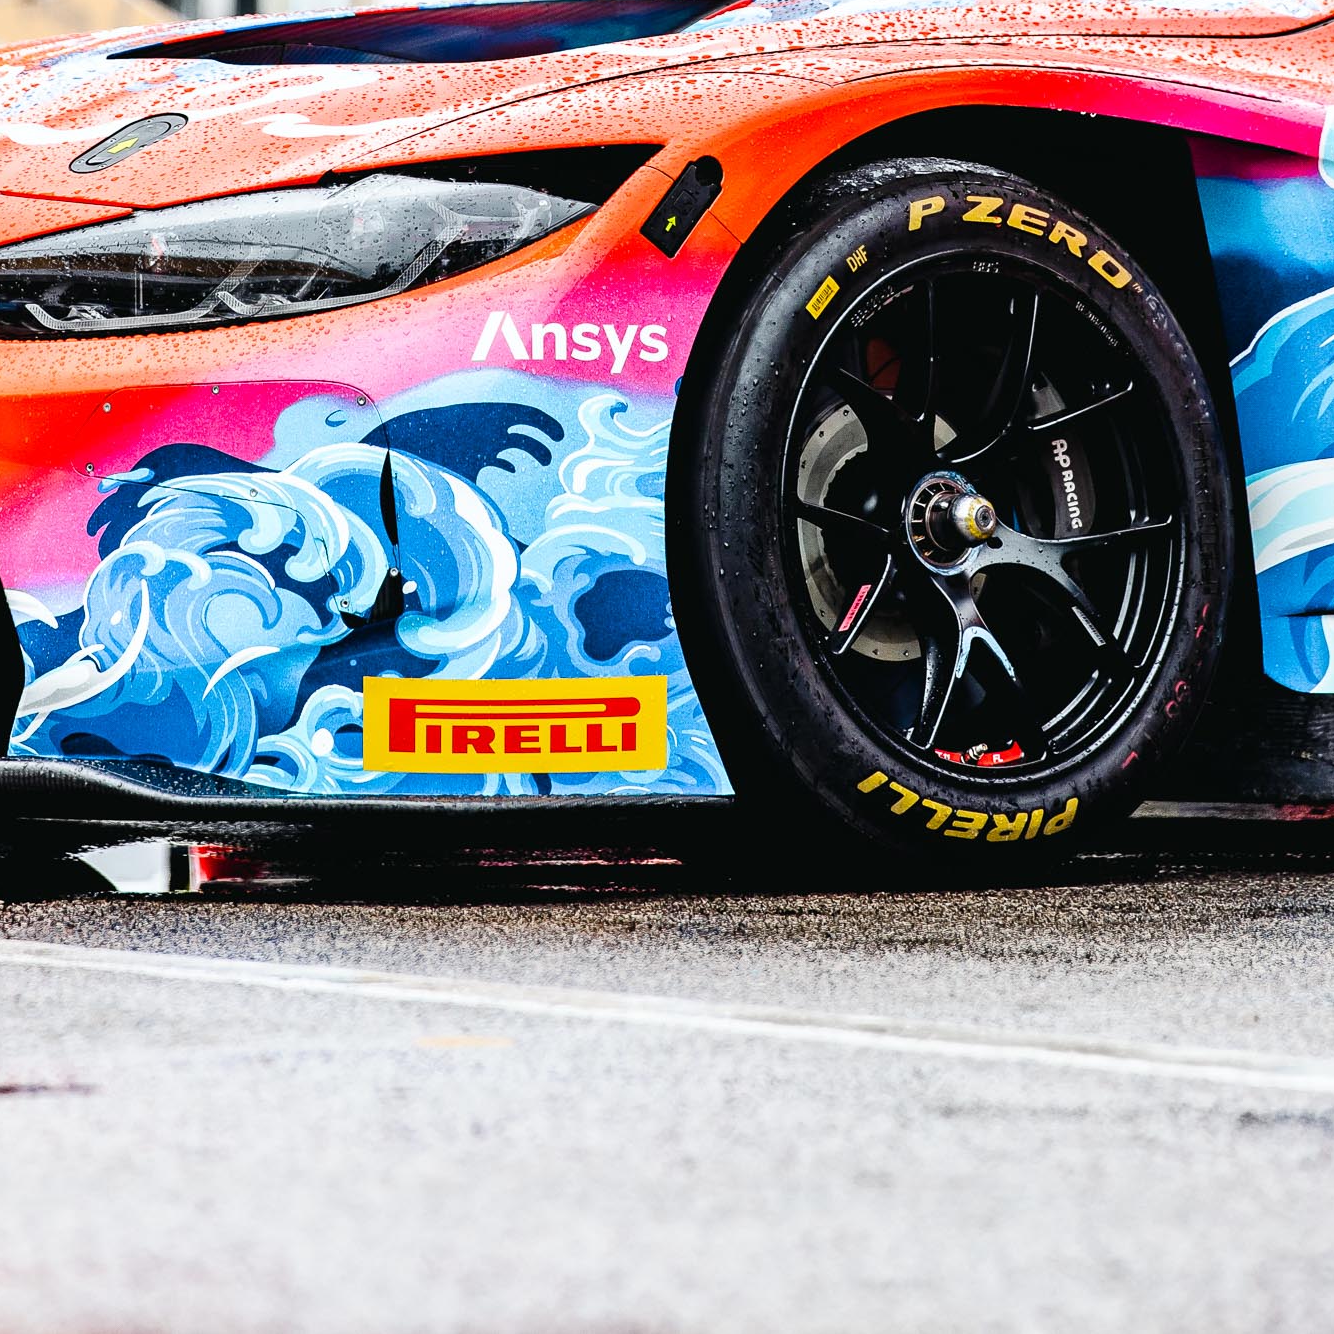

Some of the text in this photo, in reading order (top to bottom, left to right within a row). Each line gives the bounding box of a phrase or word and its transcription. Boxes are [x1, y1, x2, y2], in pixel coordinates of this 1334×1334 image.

[846, 244, 868, 273] DHF
[909, 195, 946, 232] P
[962, 195, 1134, 289] ZERO
[471, 311, 669, 374] Ansys
[1062, 469, 1083, 529] RACING
[388, 697, 641, 753] PIRELLI
[857, 771, 1079, 842] PIRELLI
